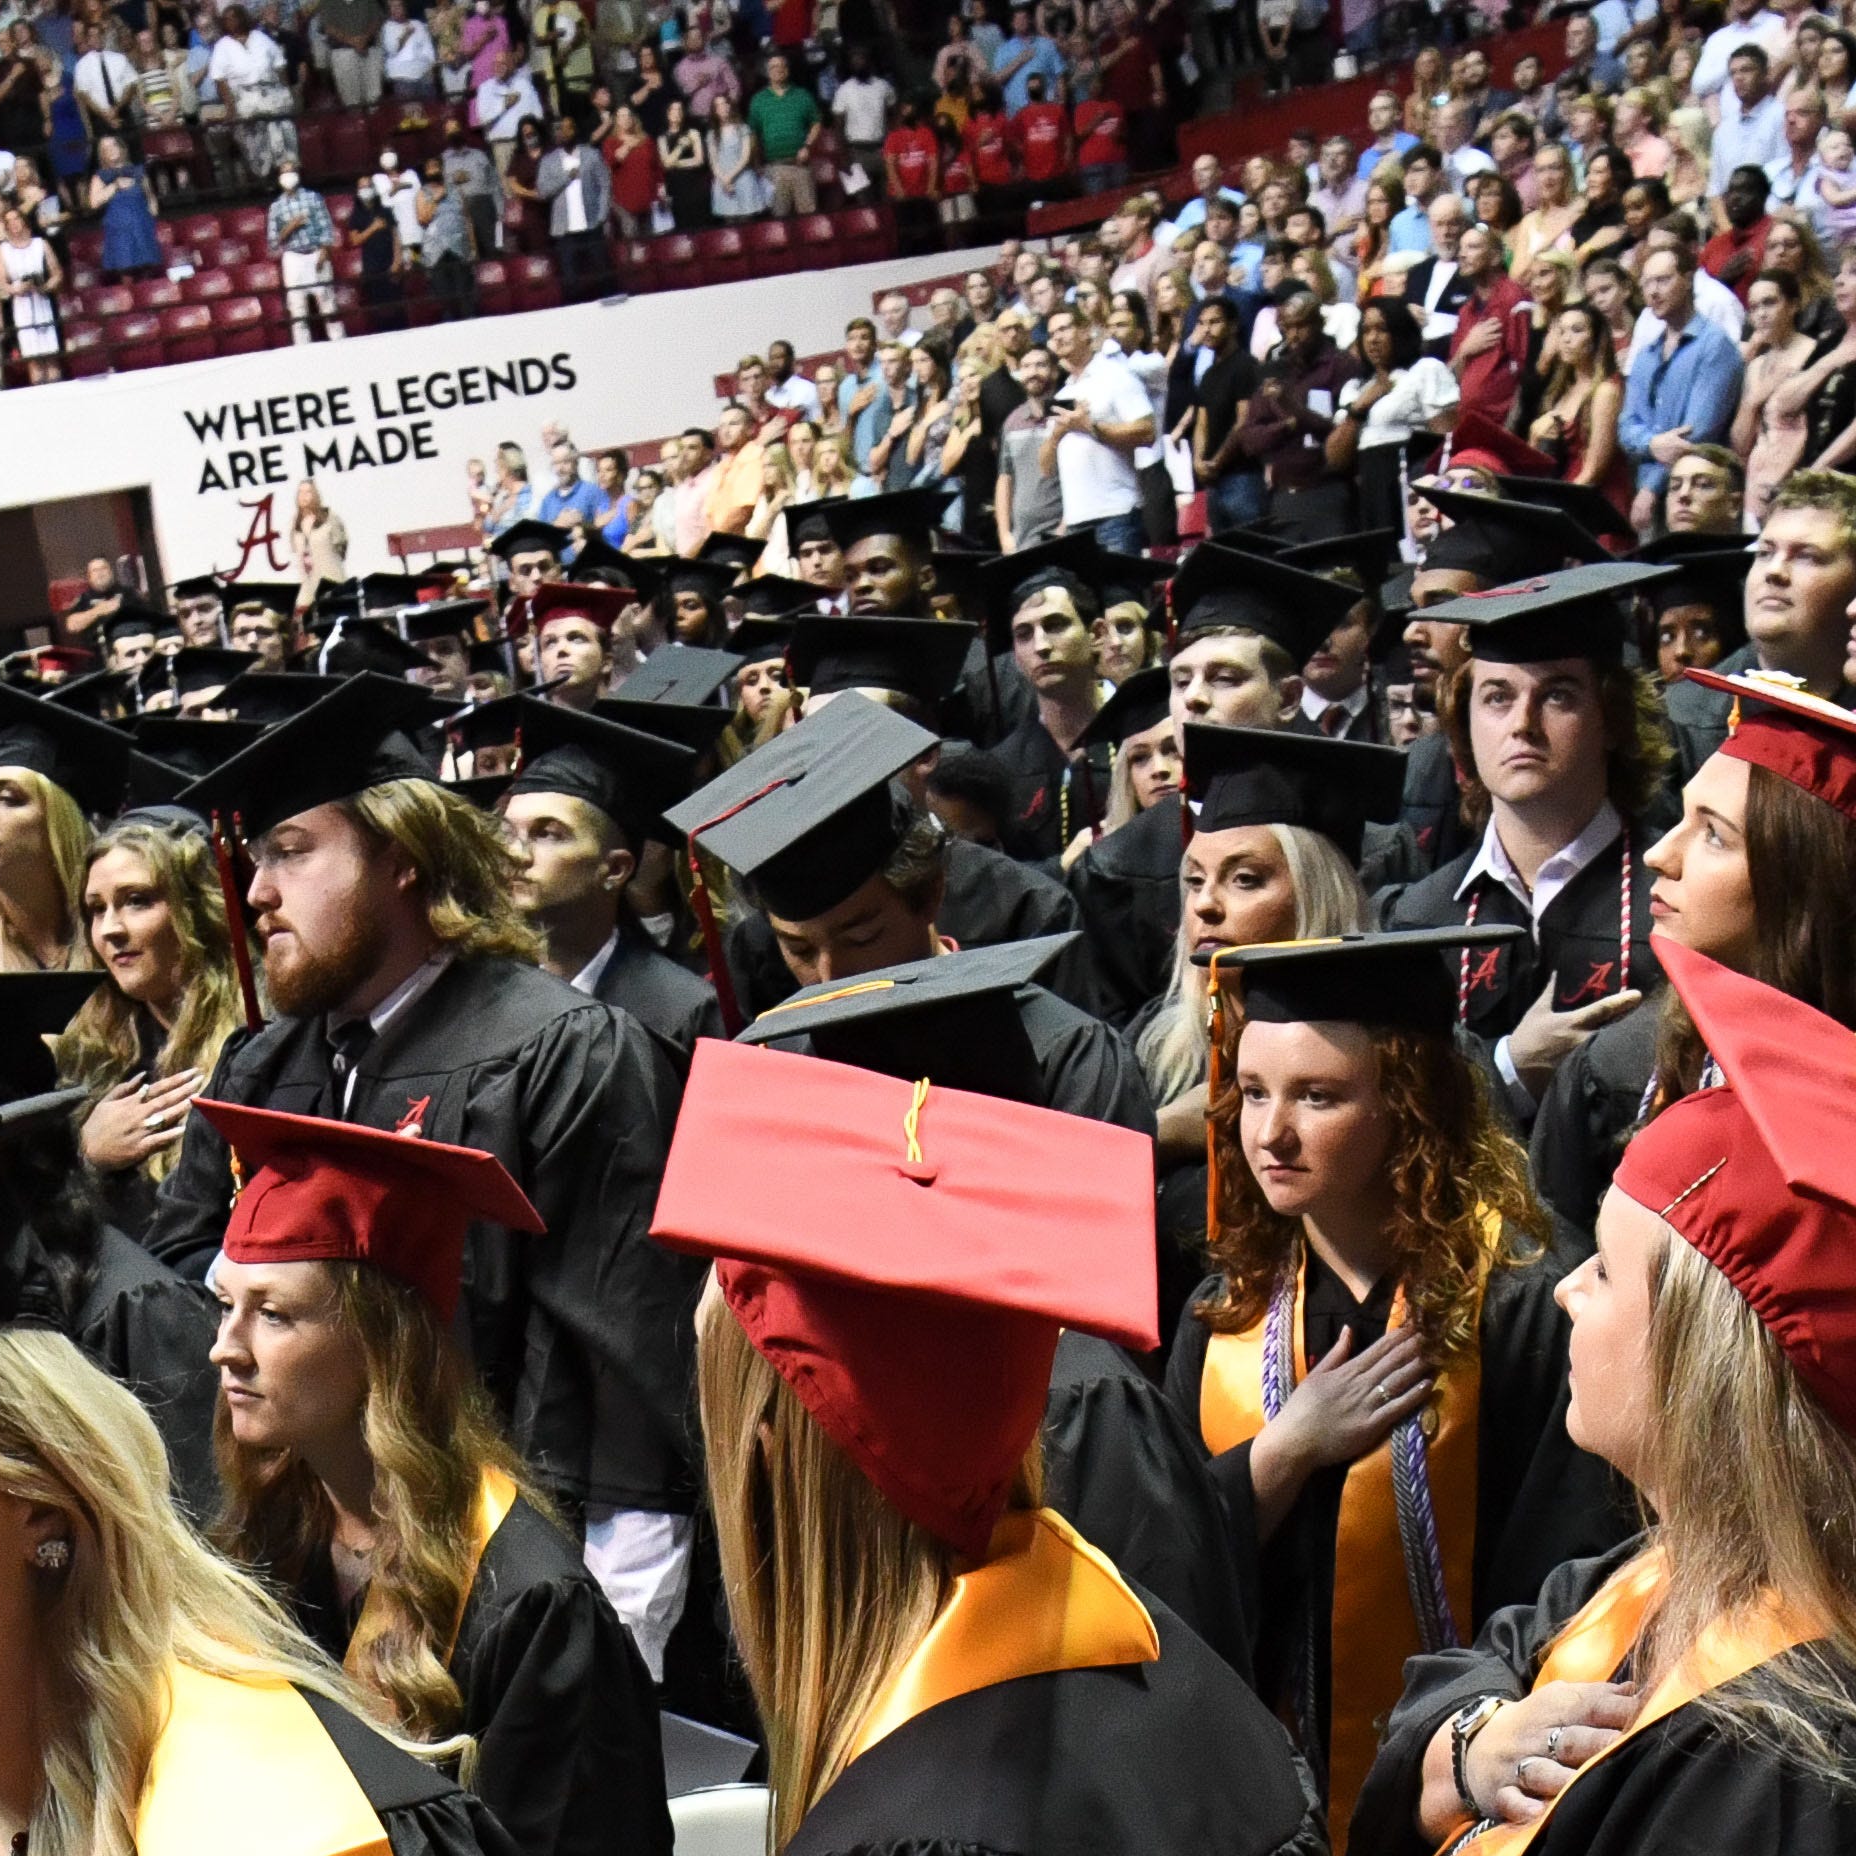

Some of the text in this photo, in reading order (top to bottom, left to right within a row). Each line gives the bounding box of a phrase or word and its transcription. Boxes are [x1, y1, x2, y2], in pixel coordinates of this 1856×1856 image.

[183, 352, 578, 445] WHERE LEGENDS
[197, 421, 439, 495] ARE MADE
